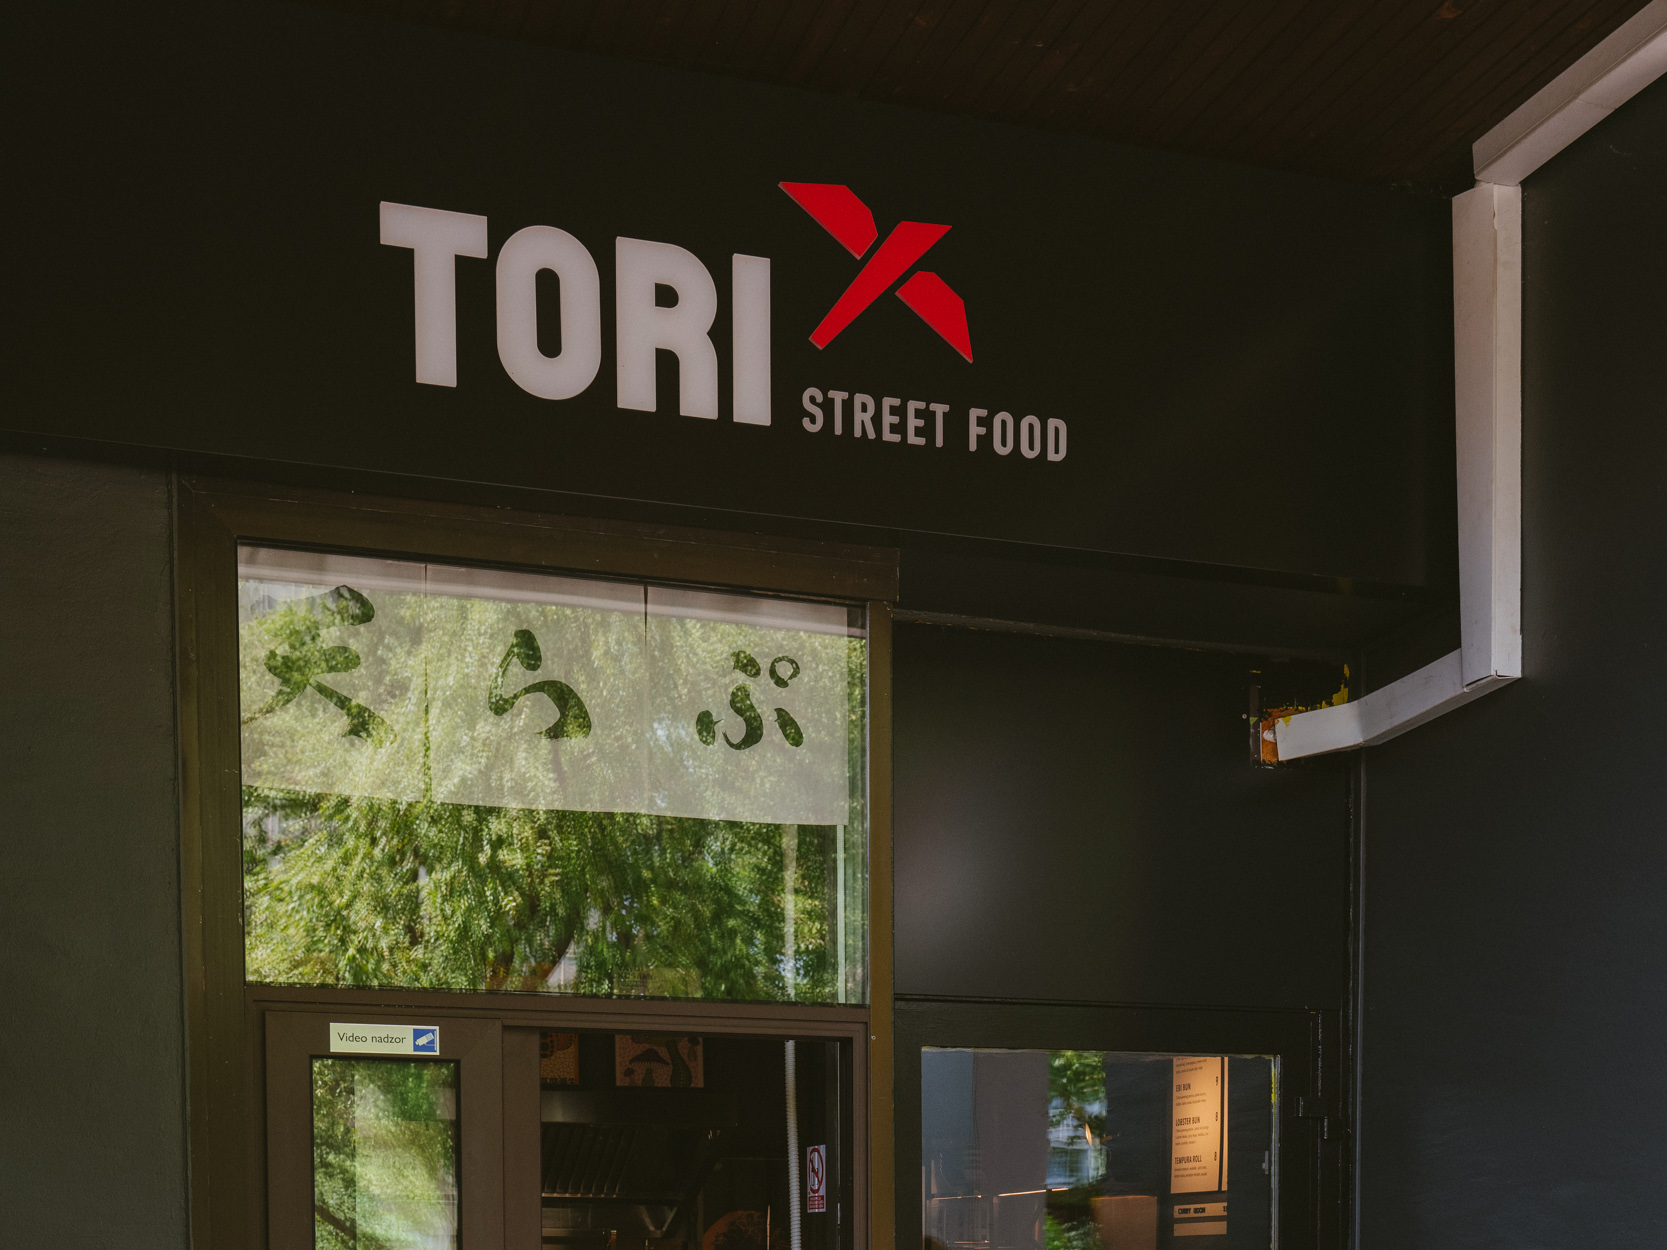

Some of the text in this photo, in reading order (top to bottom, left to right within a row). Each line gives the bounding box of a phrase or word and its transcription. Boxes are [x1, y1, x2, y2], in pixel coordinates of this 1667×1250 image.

[380, 201, 771, 426] TORI
[802, 387, 1067, 463] STREET FOOD
[337, 1032, 406, 1044] Video nadzor
[1176, 1117, 1191, 1126] LOBSTER
[1175, 1156, 1192, 1165] TEMPURA
